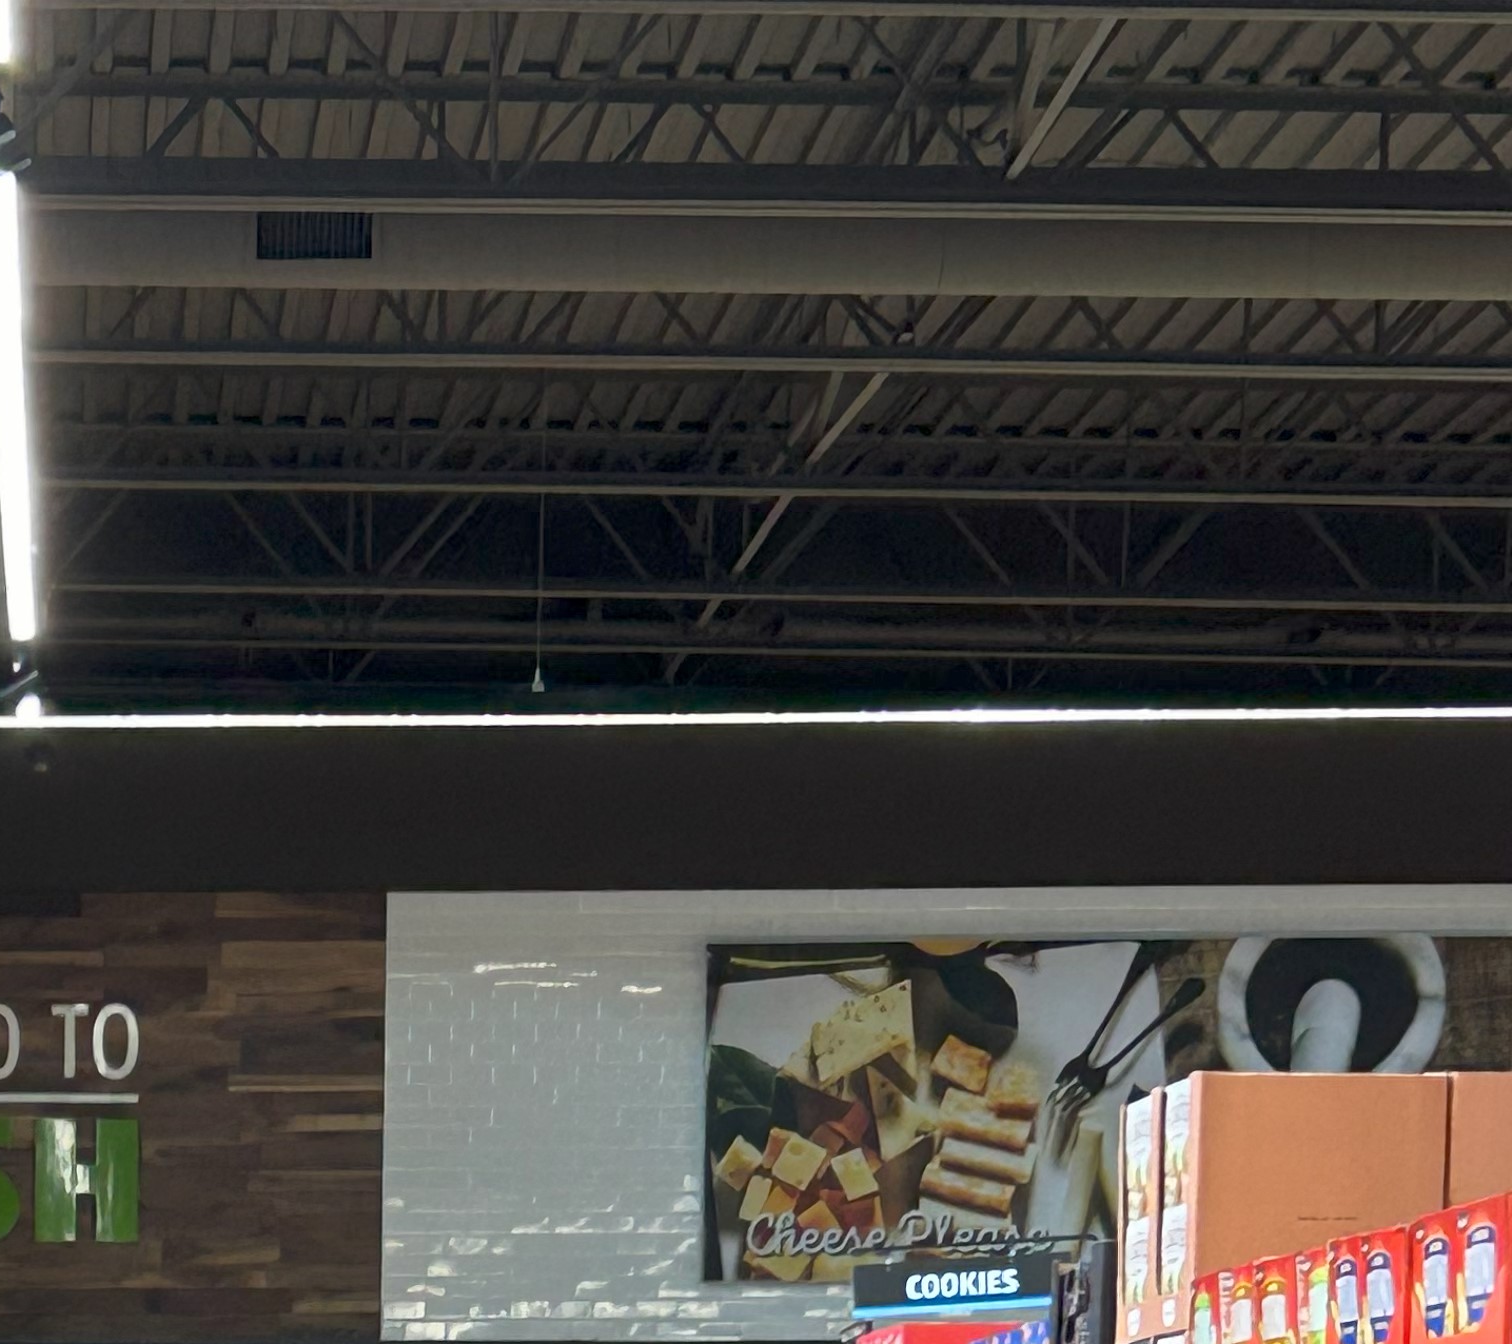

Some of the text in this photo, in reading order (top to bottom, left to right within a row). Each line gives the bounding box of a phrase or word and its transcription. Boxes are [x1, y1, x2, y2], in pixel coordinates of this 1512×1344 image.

[51, 1002, 140, 1080] TO
[746, 1211, 887, 1256] Cheese
[905, 1268, 1020, 1300] COOKIES
